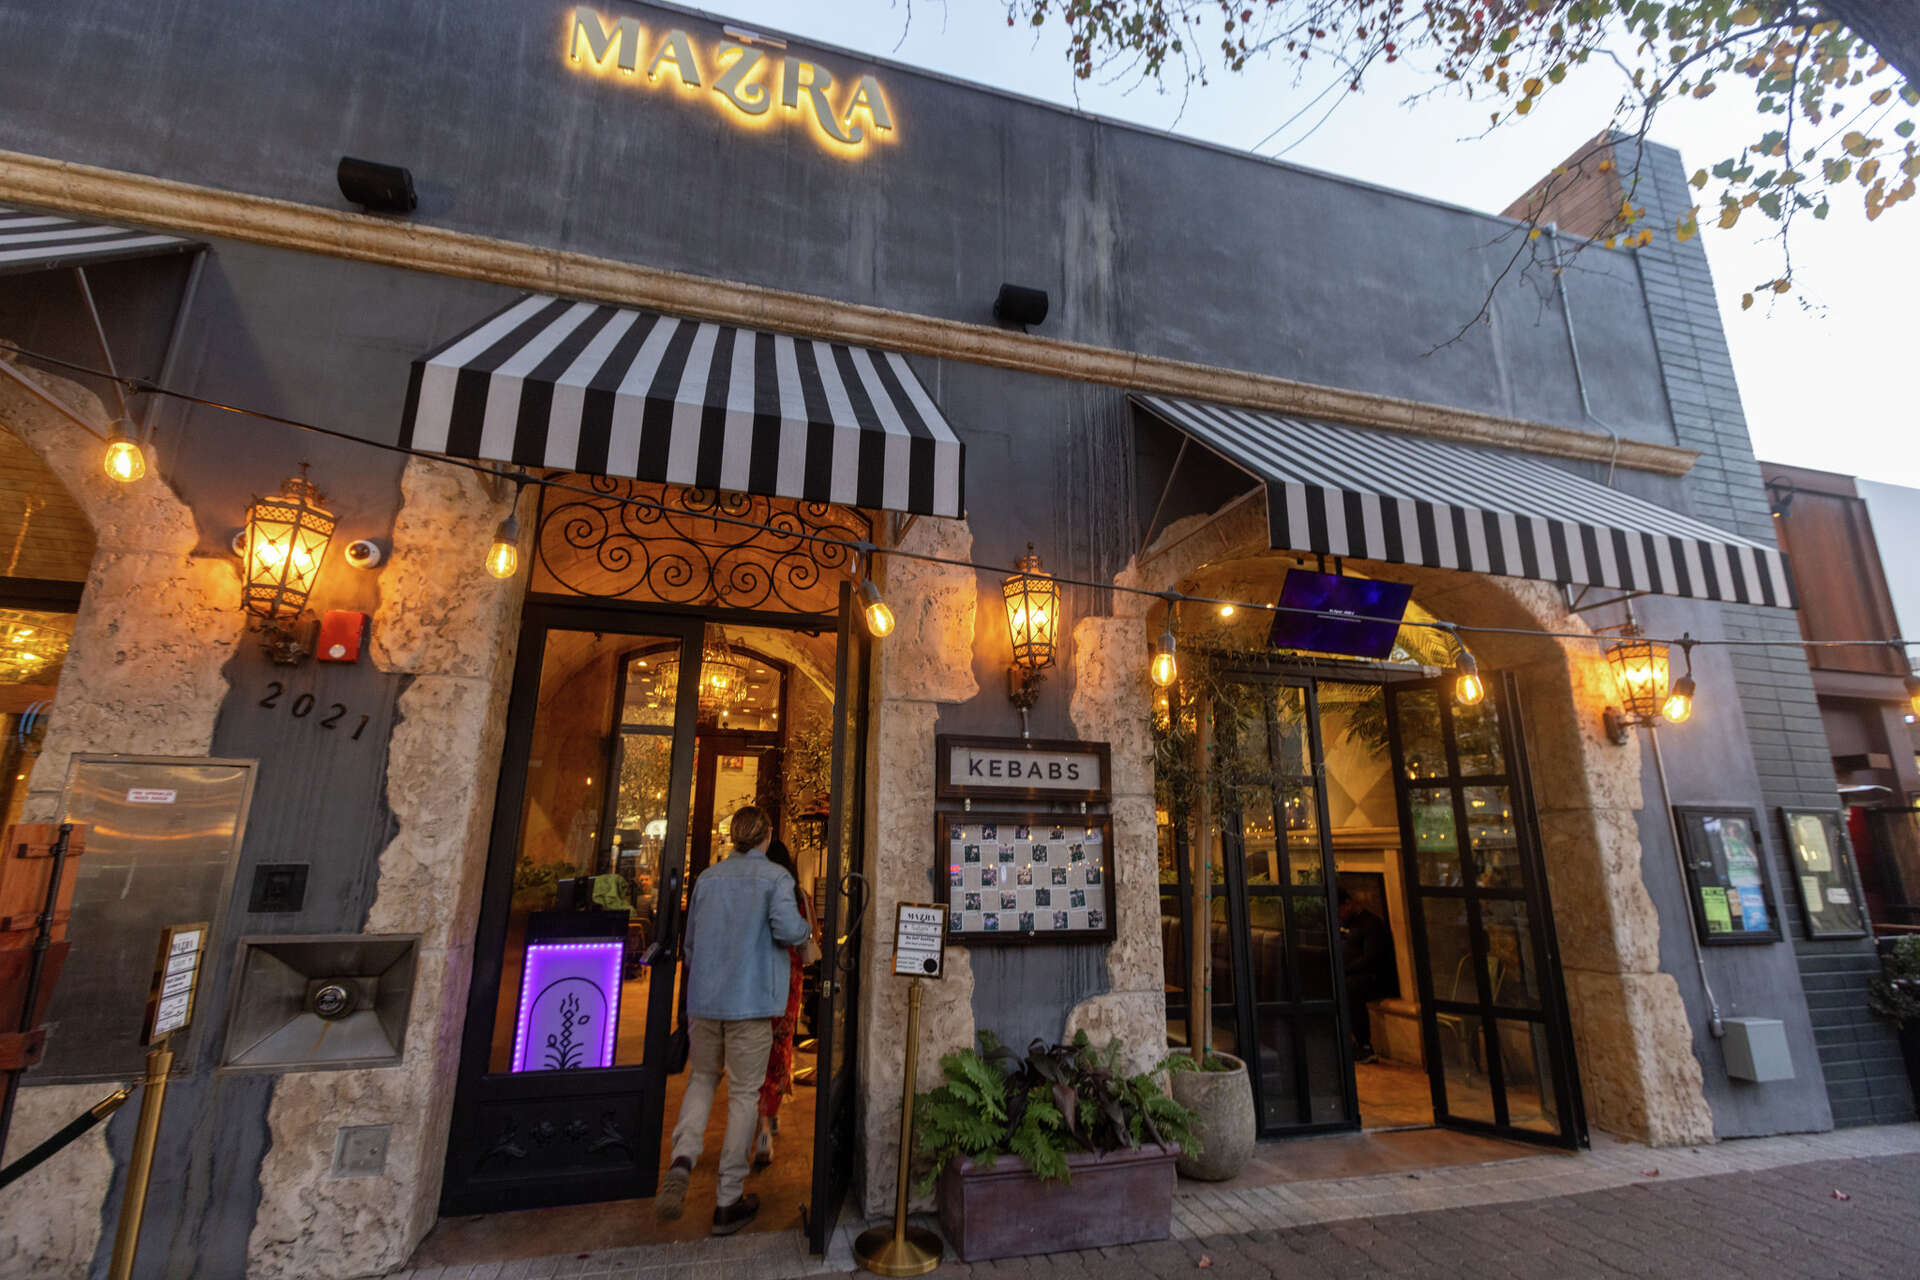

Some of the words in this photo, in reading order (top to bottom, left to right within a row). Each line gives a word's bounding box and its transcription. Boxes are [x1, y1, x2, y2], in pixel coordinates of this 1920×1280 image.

[570, 6, 893, 144] MAZRA
[259, 681, 370, 740] 2021
[968, 756, 1080, 781] KEBABS
